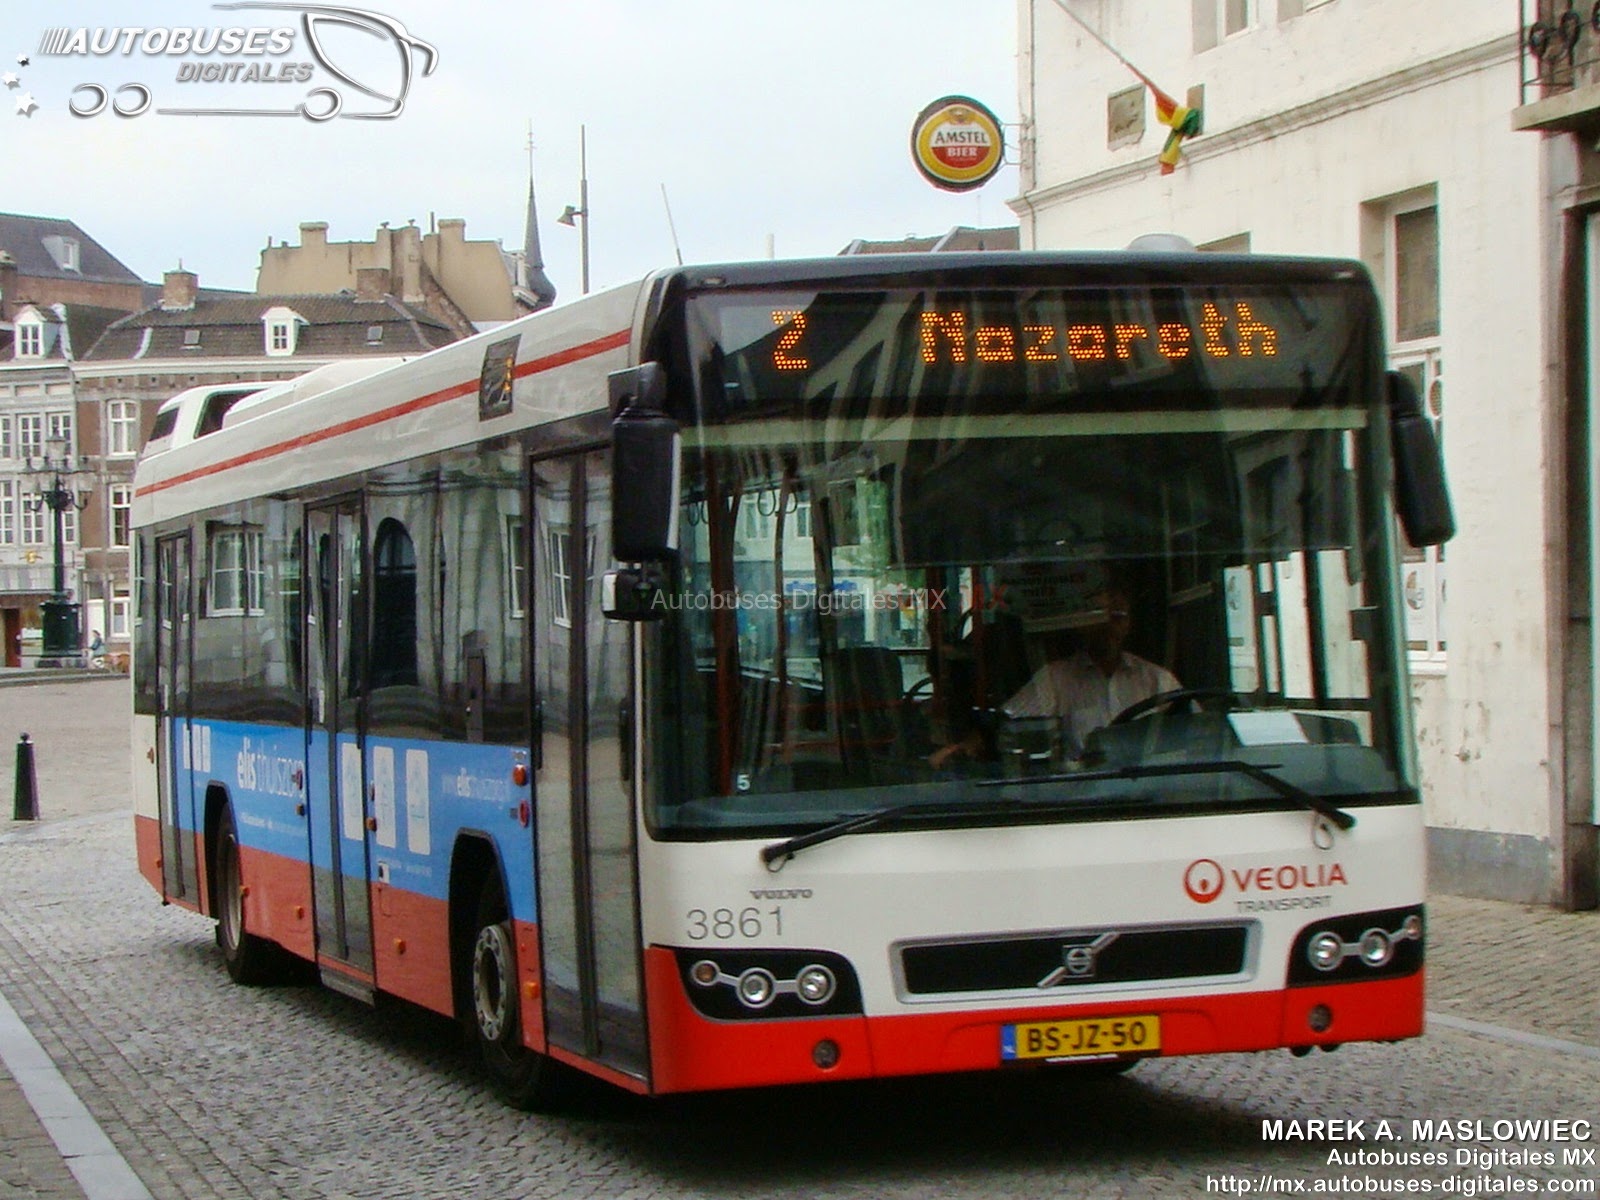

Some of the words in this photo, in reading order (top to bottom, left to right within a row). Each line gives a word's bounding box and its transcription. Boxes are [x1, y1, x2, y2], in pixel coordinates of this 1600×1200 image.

[935, 130, 988, 145] AMSTEL
[947, 147, 977, 157] BIER
[920, 303, 1276, 363] Nazareth
[736, 773, 751, 791] 5
[1231, 863, 1349, 892] VEOLIA
[750, 888, 813, 900] VOLVO
[1235, 895, 1332, 913] TRANSPORT
[686, 906, 783, 940] 3861
[1027, 1021, 1147, 1053] BS-JZ-50
